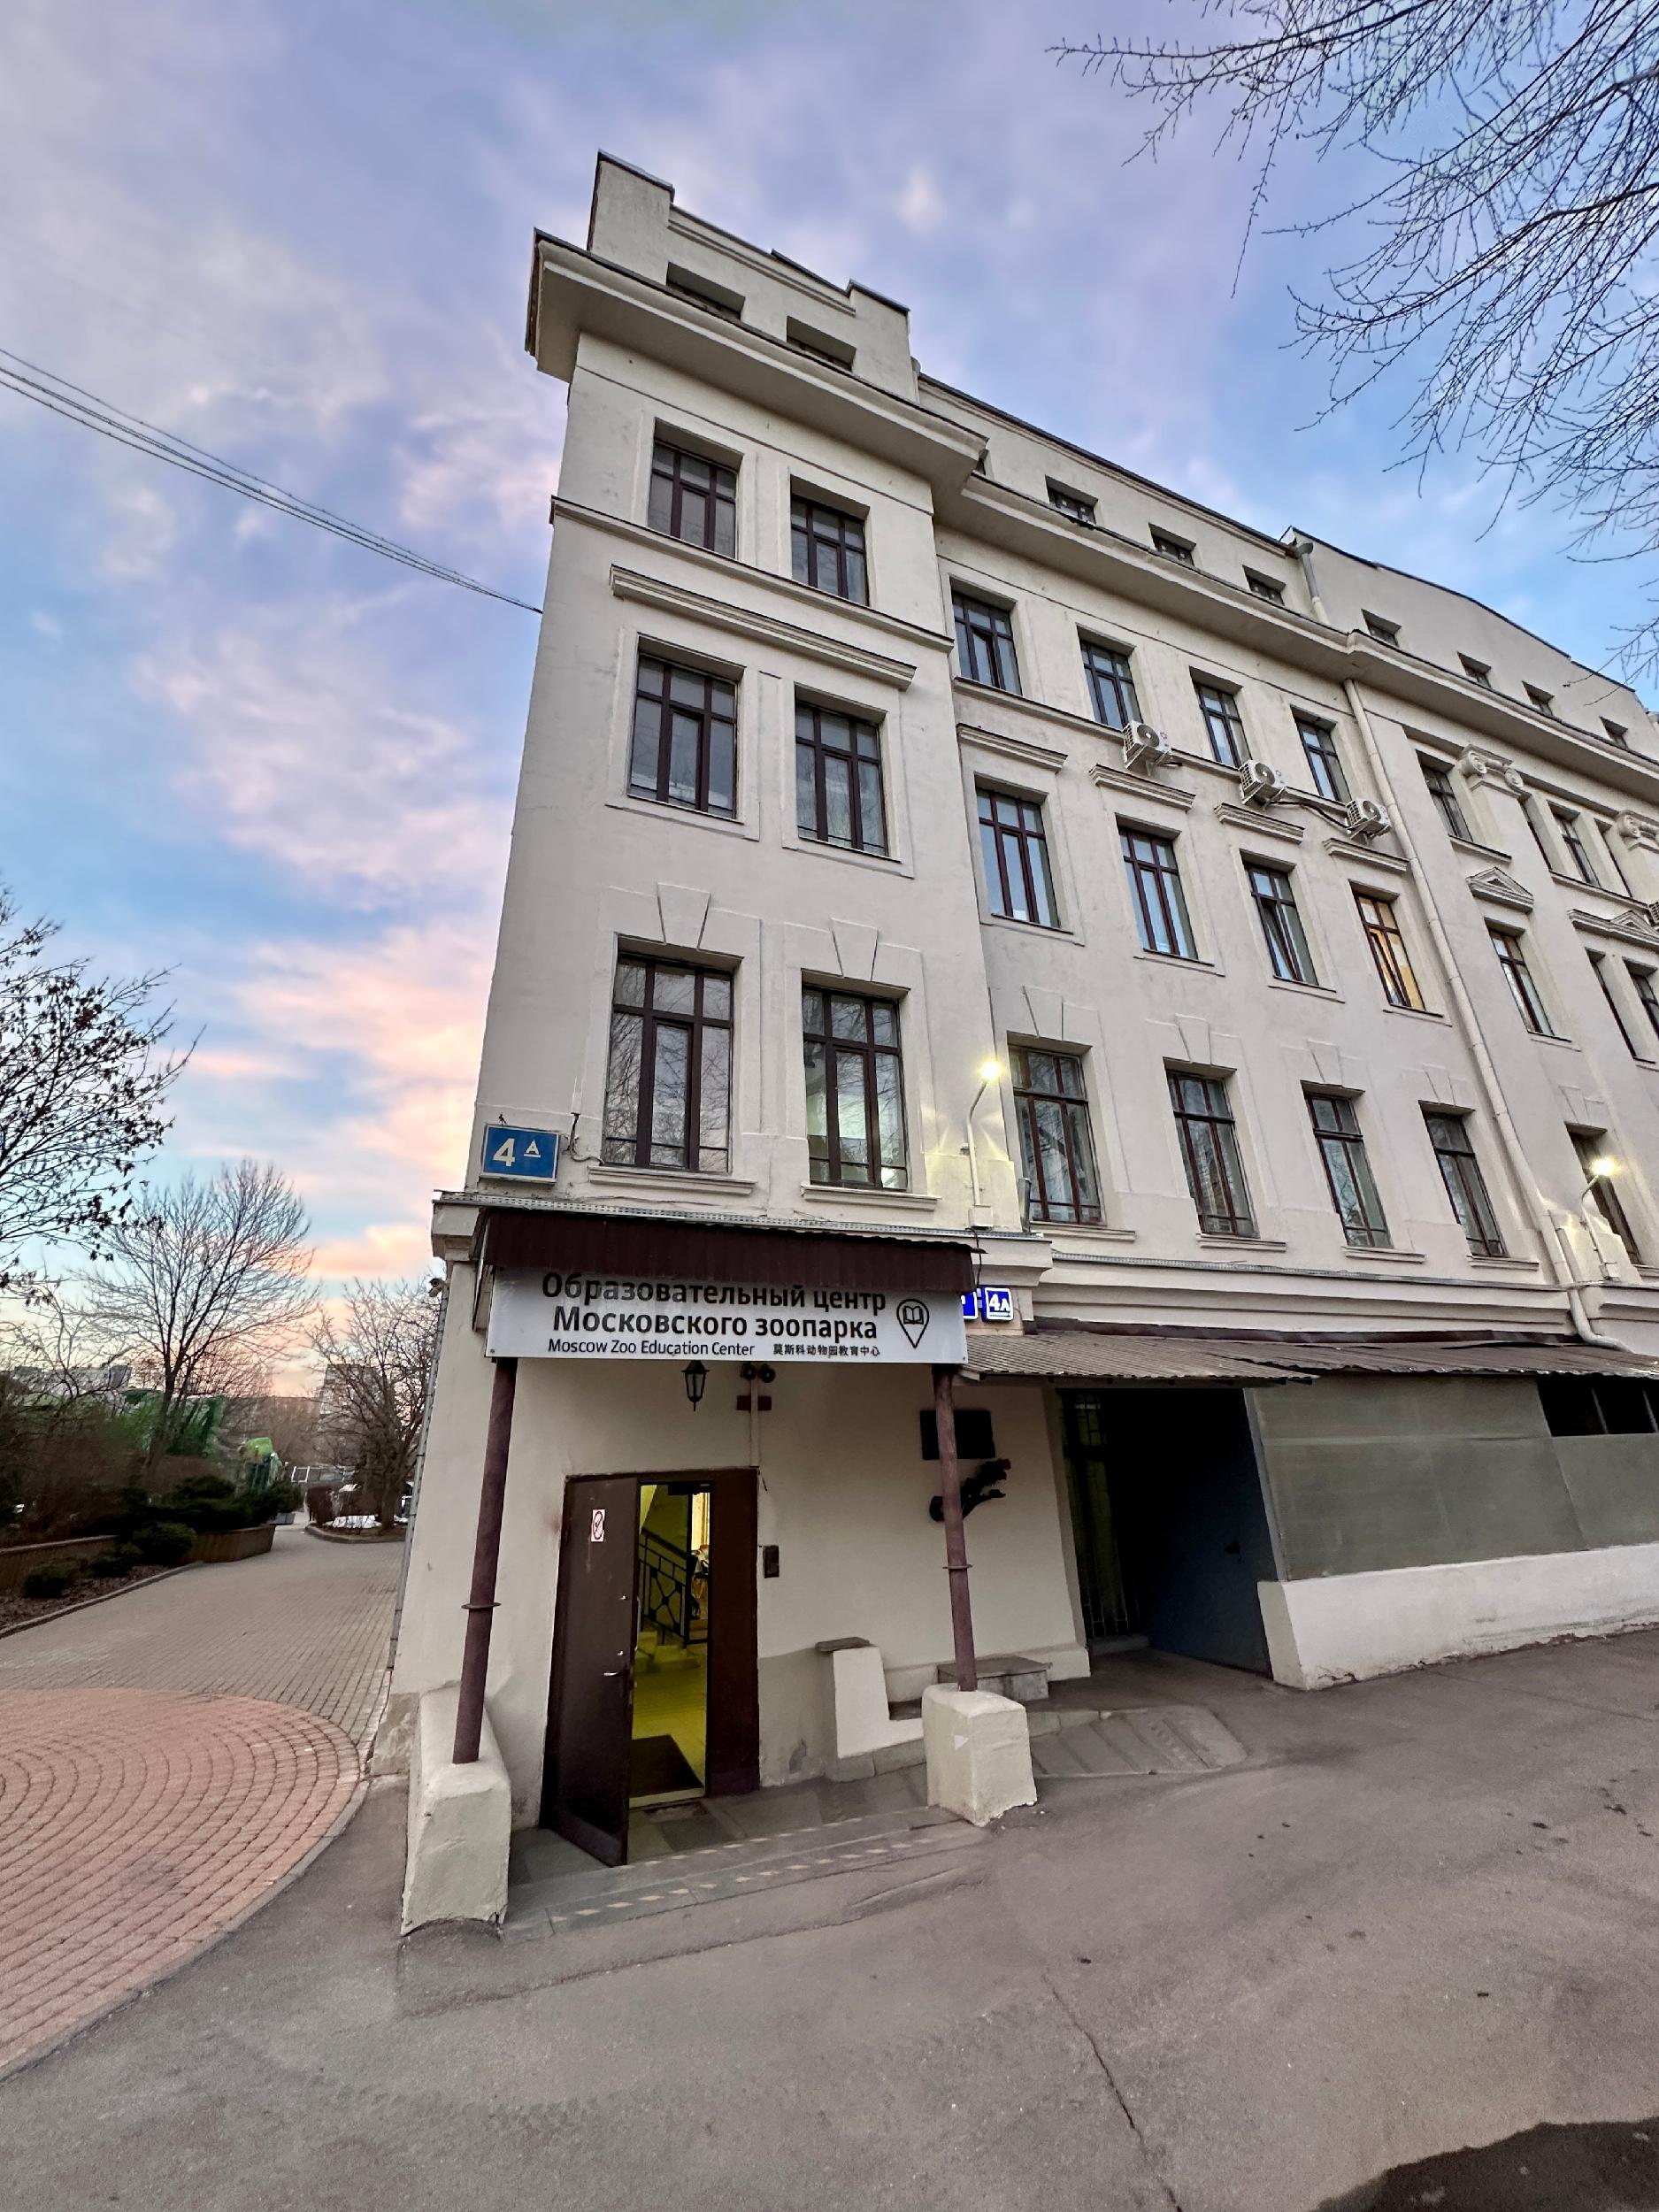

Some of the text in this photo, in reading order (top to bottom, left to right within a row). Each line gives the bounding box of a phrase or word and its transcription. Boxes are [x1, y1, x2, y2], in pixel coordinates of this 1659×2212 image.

[542, 1272, 886, 1316] Образовательный центр
[553, 1305, 877, 1343] Московского зоопарка
[548, 1338, 755, 1356] Moscow Zoo Education Center
[772, 1343, 881, 1357] 莫斯科动物园教育中心
